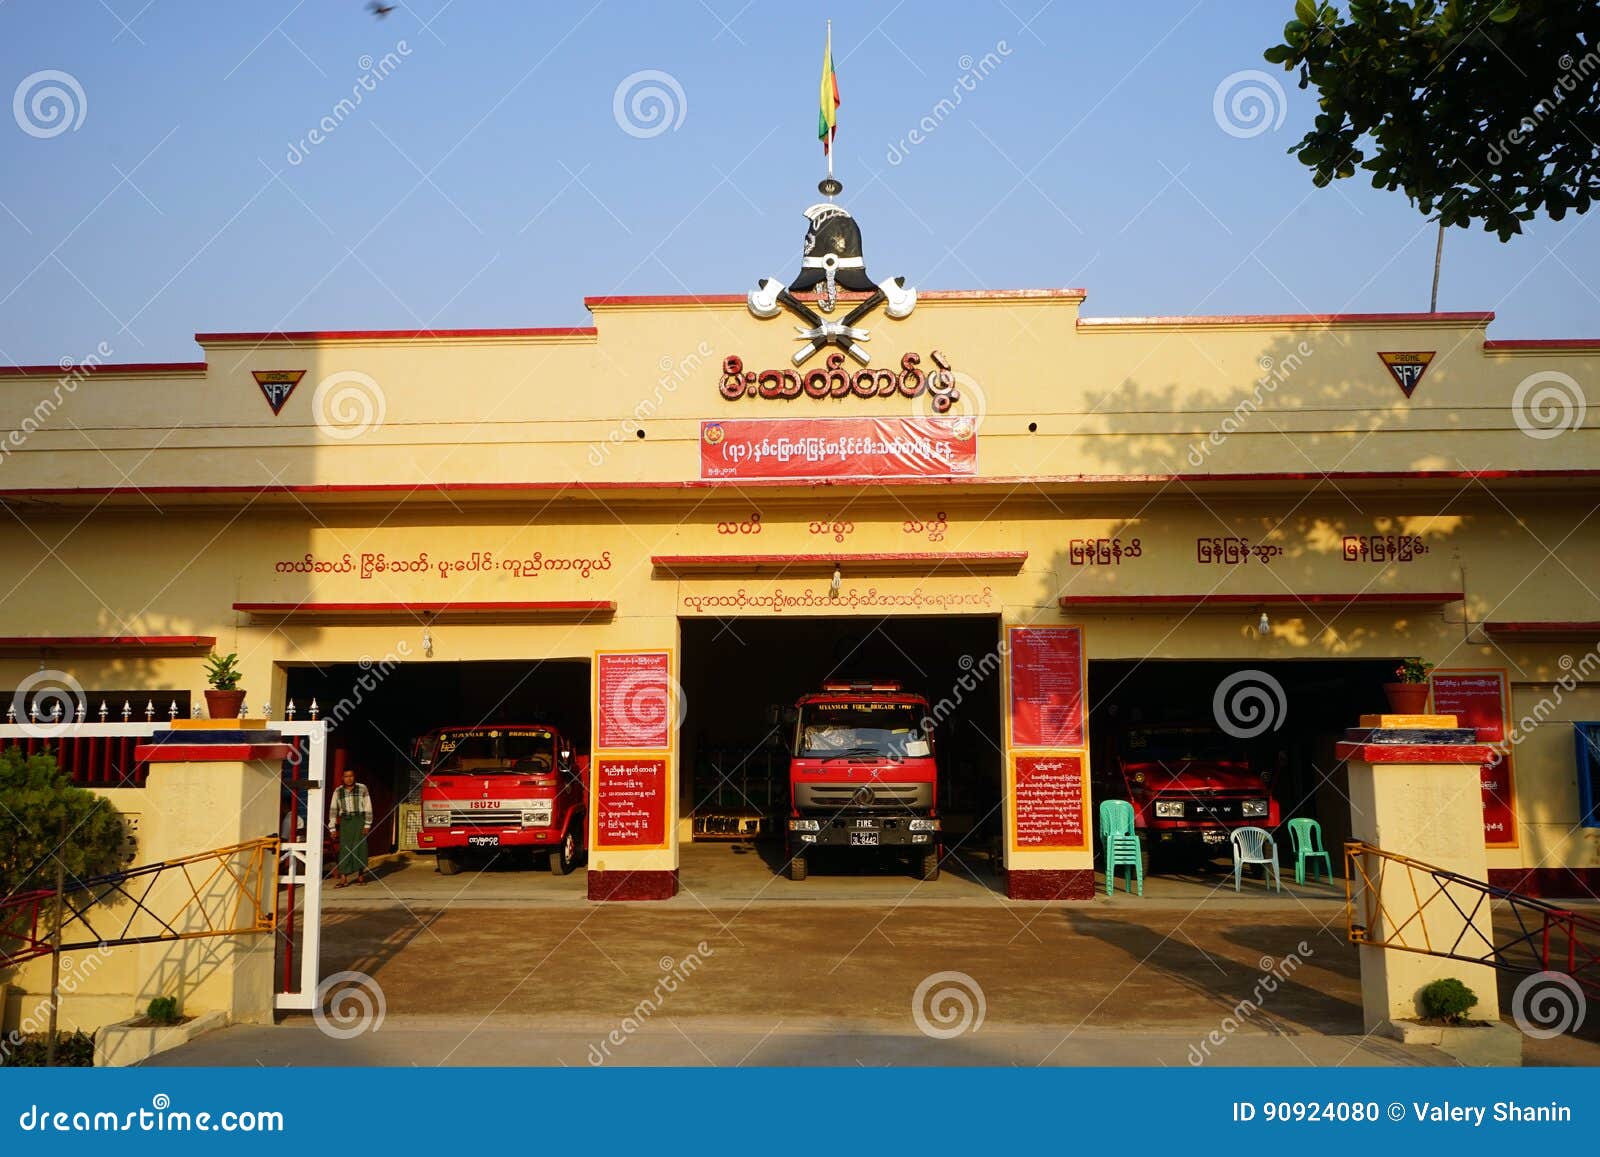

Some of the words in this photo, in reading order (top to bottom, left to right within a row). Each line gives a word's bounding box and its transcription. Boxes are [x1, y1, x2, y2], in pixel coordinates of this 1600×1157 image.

[719, 350, 960, 413] မီးသတ်တပ်ဖွဲ့
[717, 512, 761, 534] သတိ
[809, 520, 854, 543] သစ္စာ
[903, 511, 947, 542] သတ္တိ
[1069, 538, 1142, 565] မြန်မြန်သိ
[1197, 538, 1283, 565] မြန်မြန်သွား
[856, 819, 873, 828] FIRE
